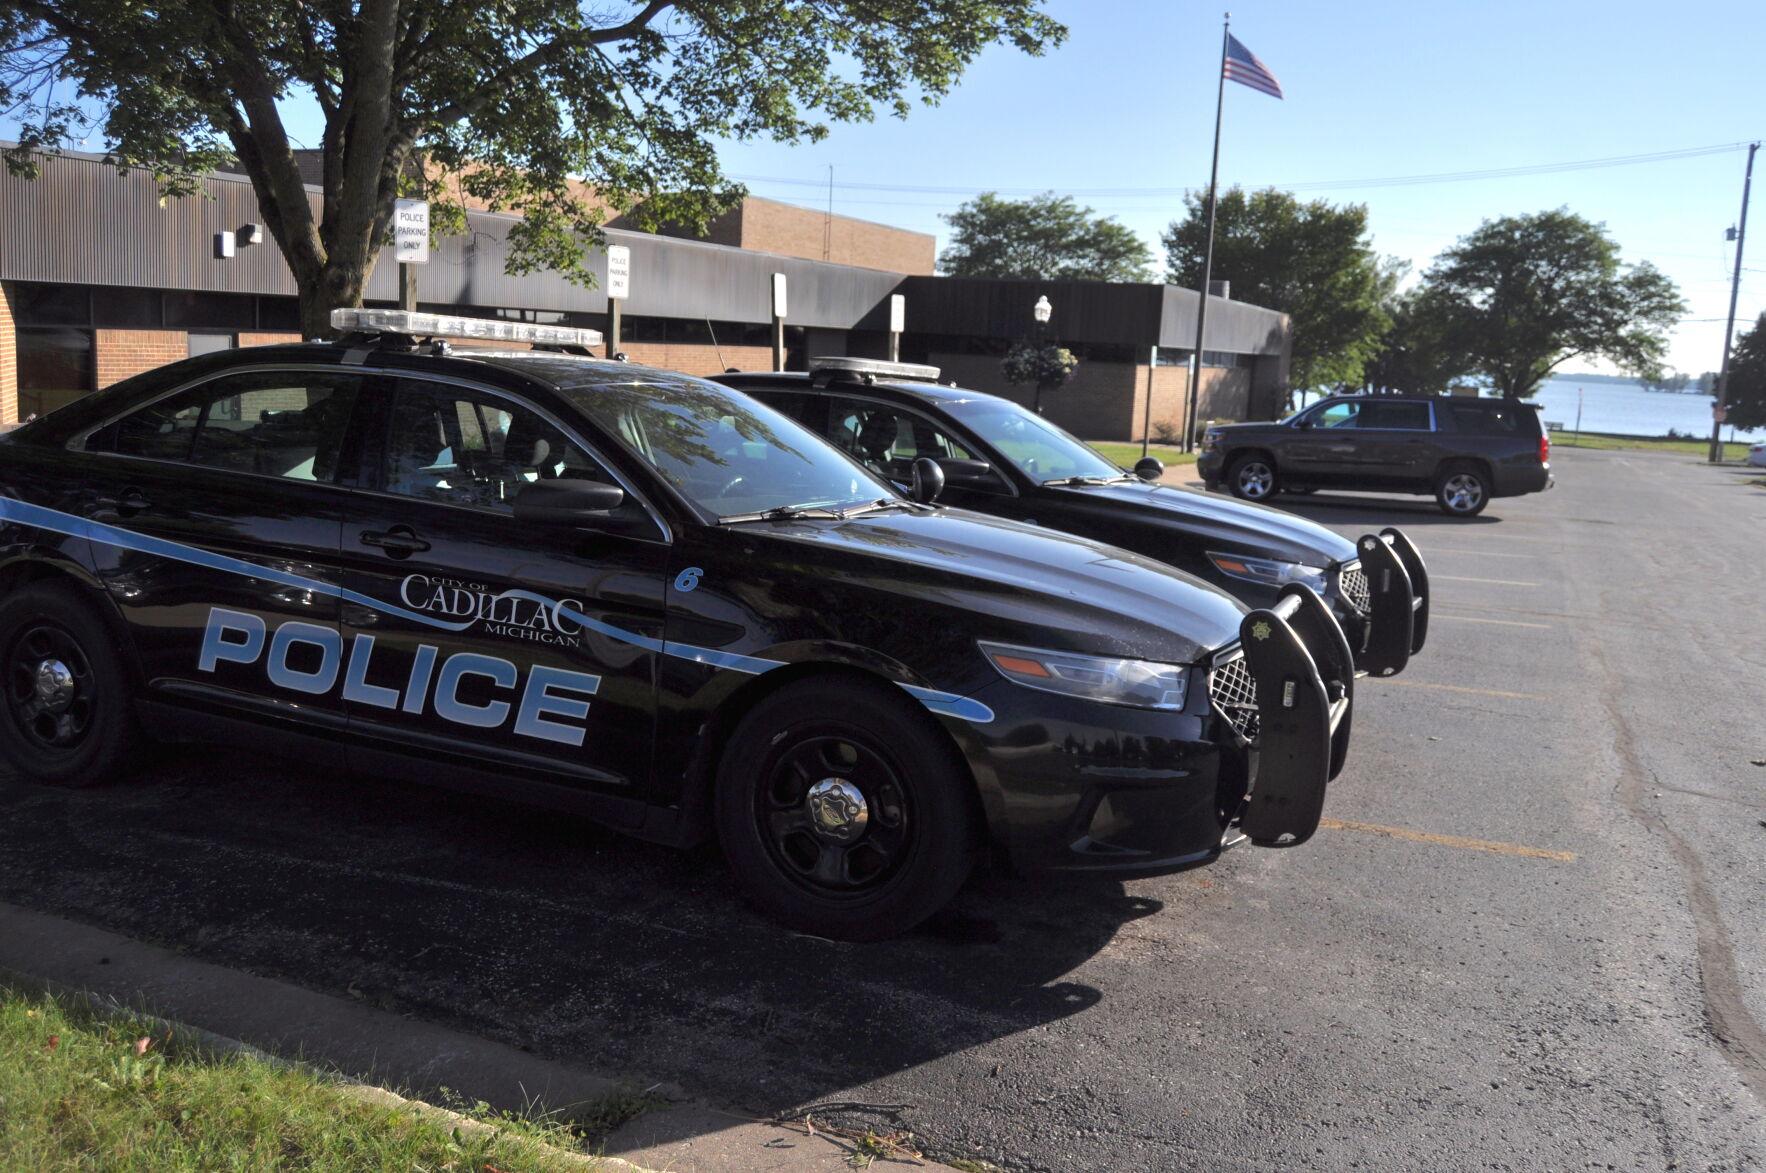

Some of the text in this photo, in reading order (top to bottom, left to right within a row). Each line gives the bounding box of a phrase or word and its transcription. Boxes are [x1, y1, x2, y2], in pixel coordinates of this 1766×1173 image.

[400, 212, 425, 222] POLICE
[398, 226, 427, 237] PARKING
[403, 240, 421, 250] ONLY
[431, 576, 489, 592] CITY OF
[674, 566, 704, 592] 6
[400, 573, 584, 635] CADILLAC
[485, 623, 581, 648] MICHIGAN
[198, 606, 602, 747] POLICE
